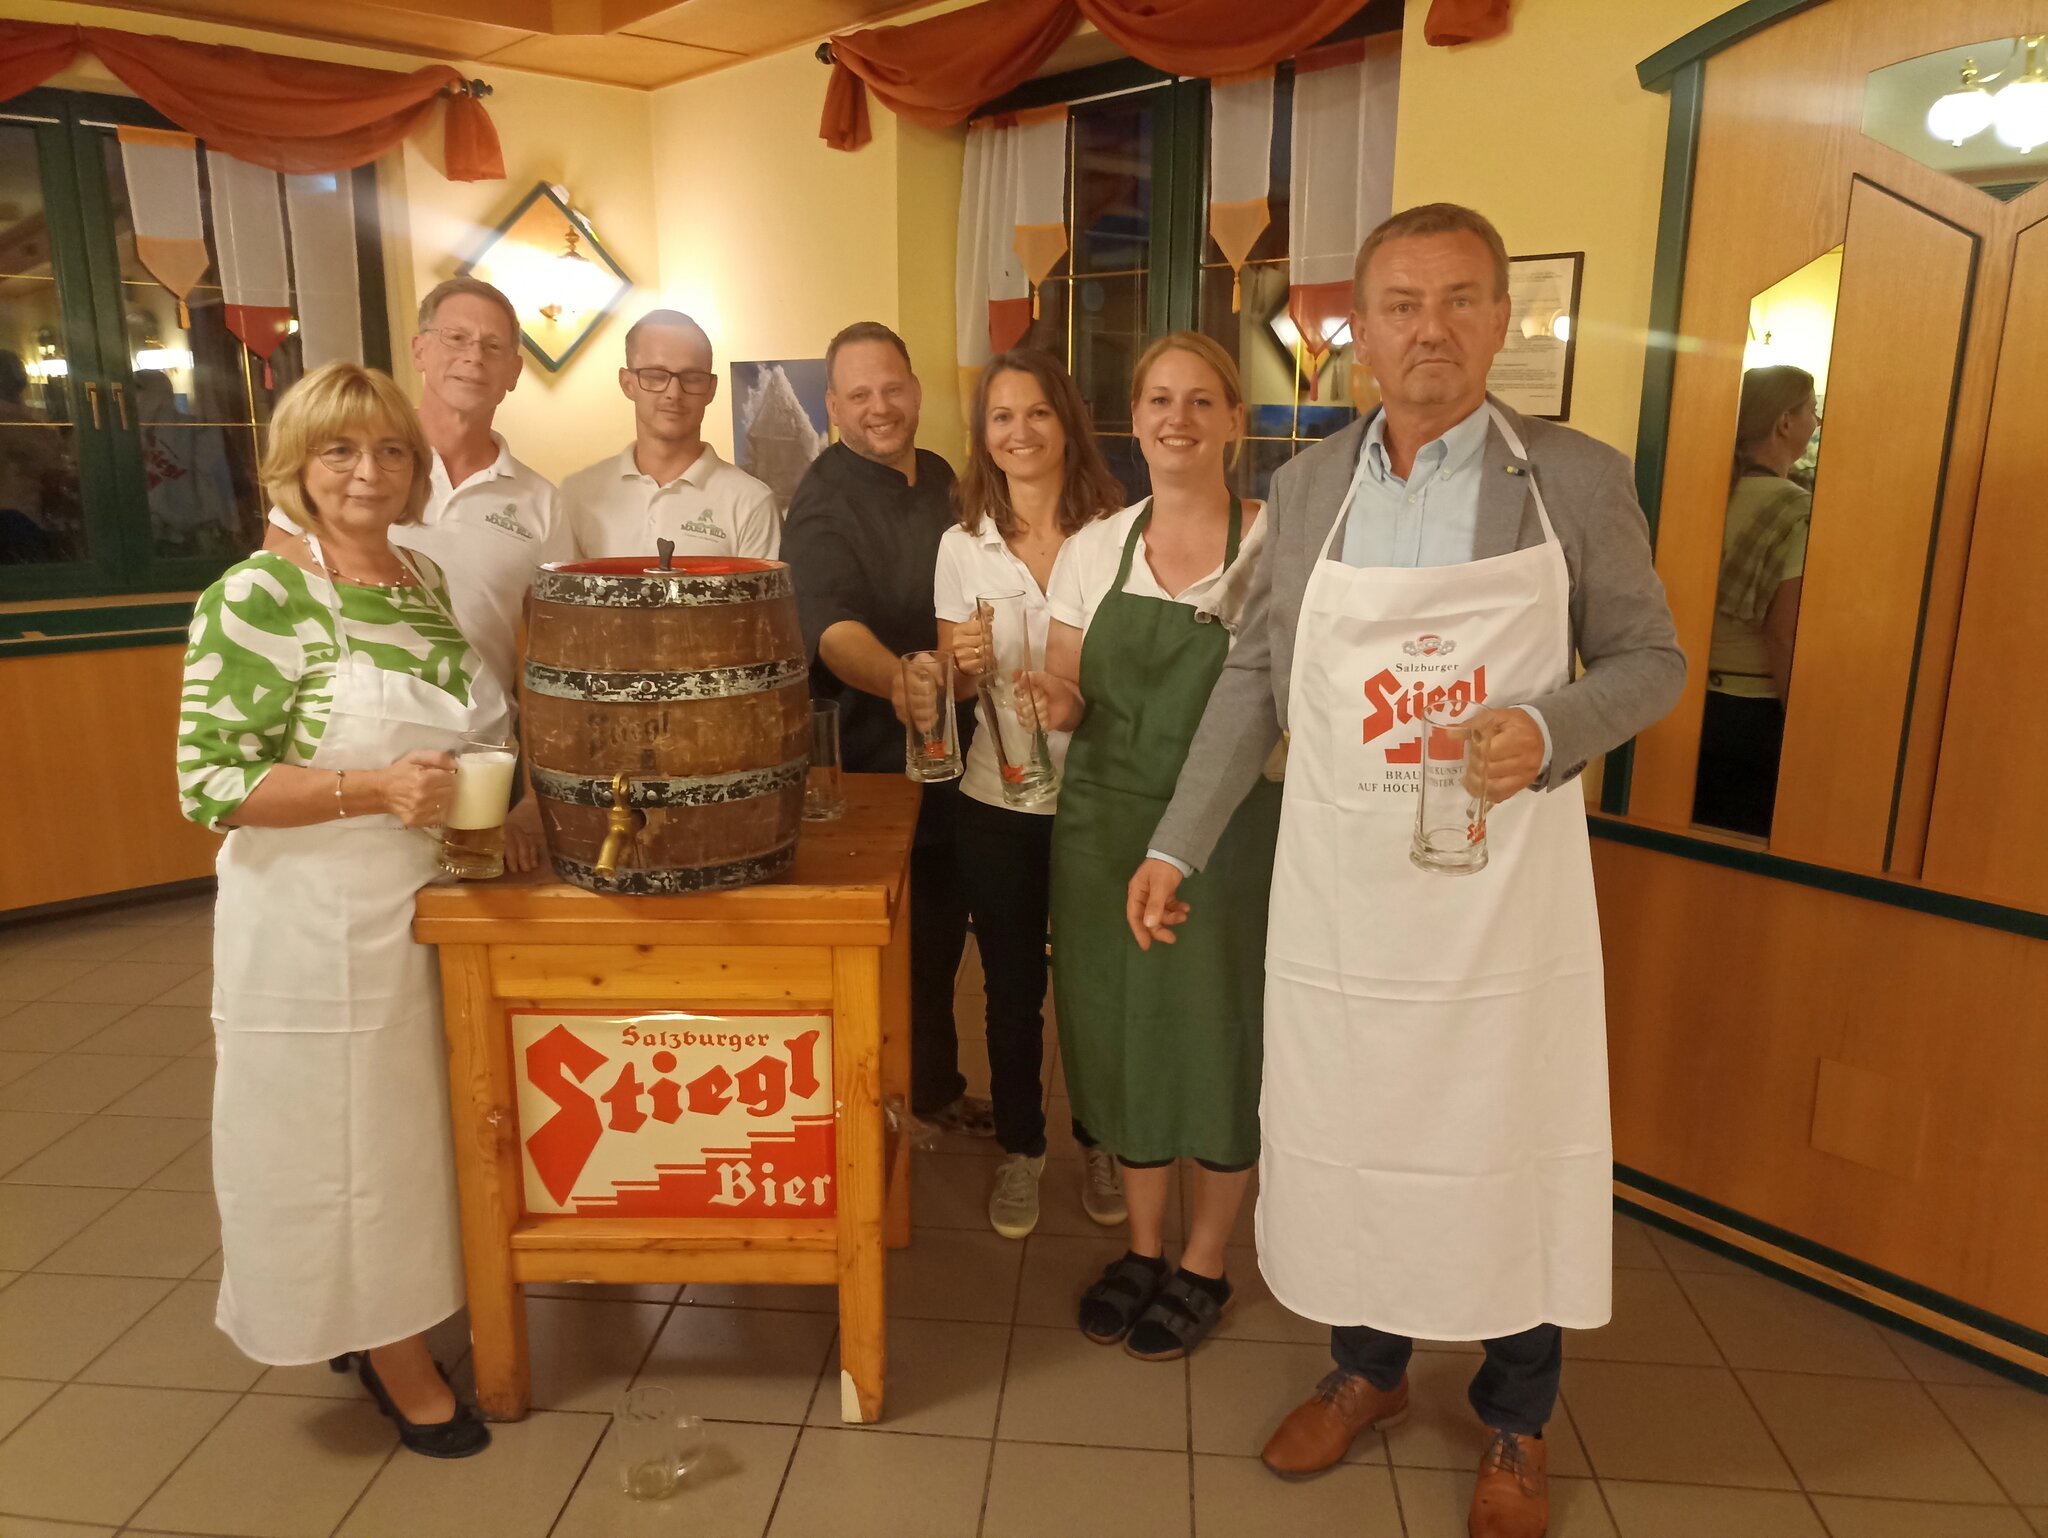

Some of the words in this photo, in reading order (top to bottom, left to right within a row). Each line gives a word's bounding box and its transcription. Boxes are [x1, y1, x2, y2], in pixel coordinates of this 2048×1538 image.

[1395, 663, 1459, 673] Salzburger
[1362, 664, 1488, 745] Stiegl
[1358, 783, 1378, 792] AUF
[622, 1025, 769, 1051] Salzburger
[525, 1024, 820, 1207] Stiegl
[708, 1161, 831, 1206] Bier
